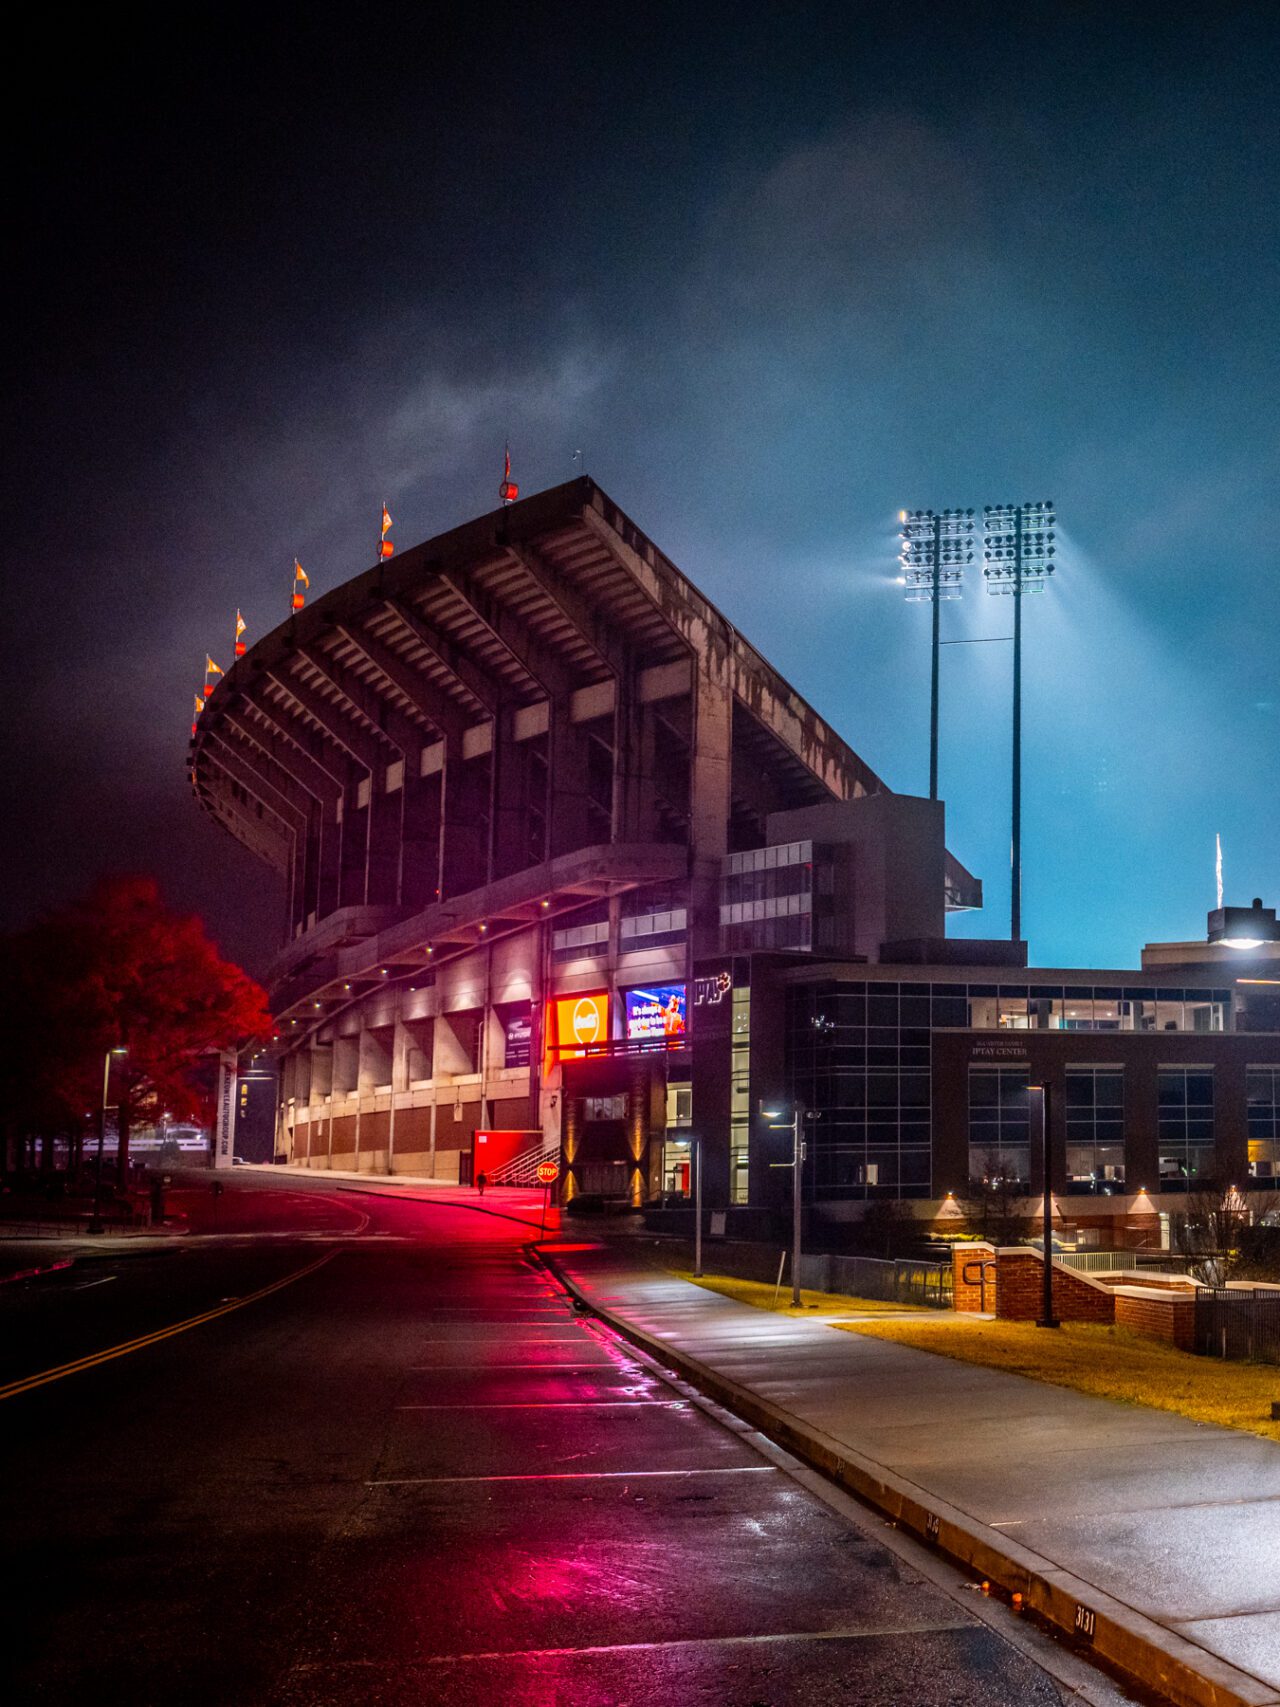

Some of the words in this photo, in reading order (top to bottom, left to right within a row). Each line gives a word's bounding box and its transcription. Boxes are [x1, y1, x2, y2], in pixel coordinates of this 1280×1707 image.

[972, 1047, 995, 1056] IPTAY
[996, 1047, 1028, 1056] CENTER
[539, 1167, 557, 1176] STOP
[1075, 1605, 1095, 1636] 3131
